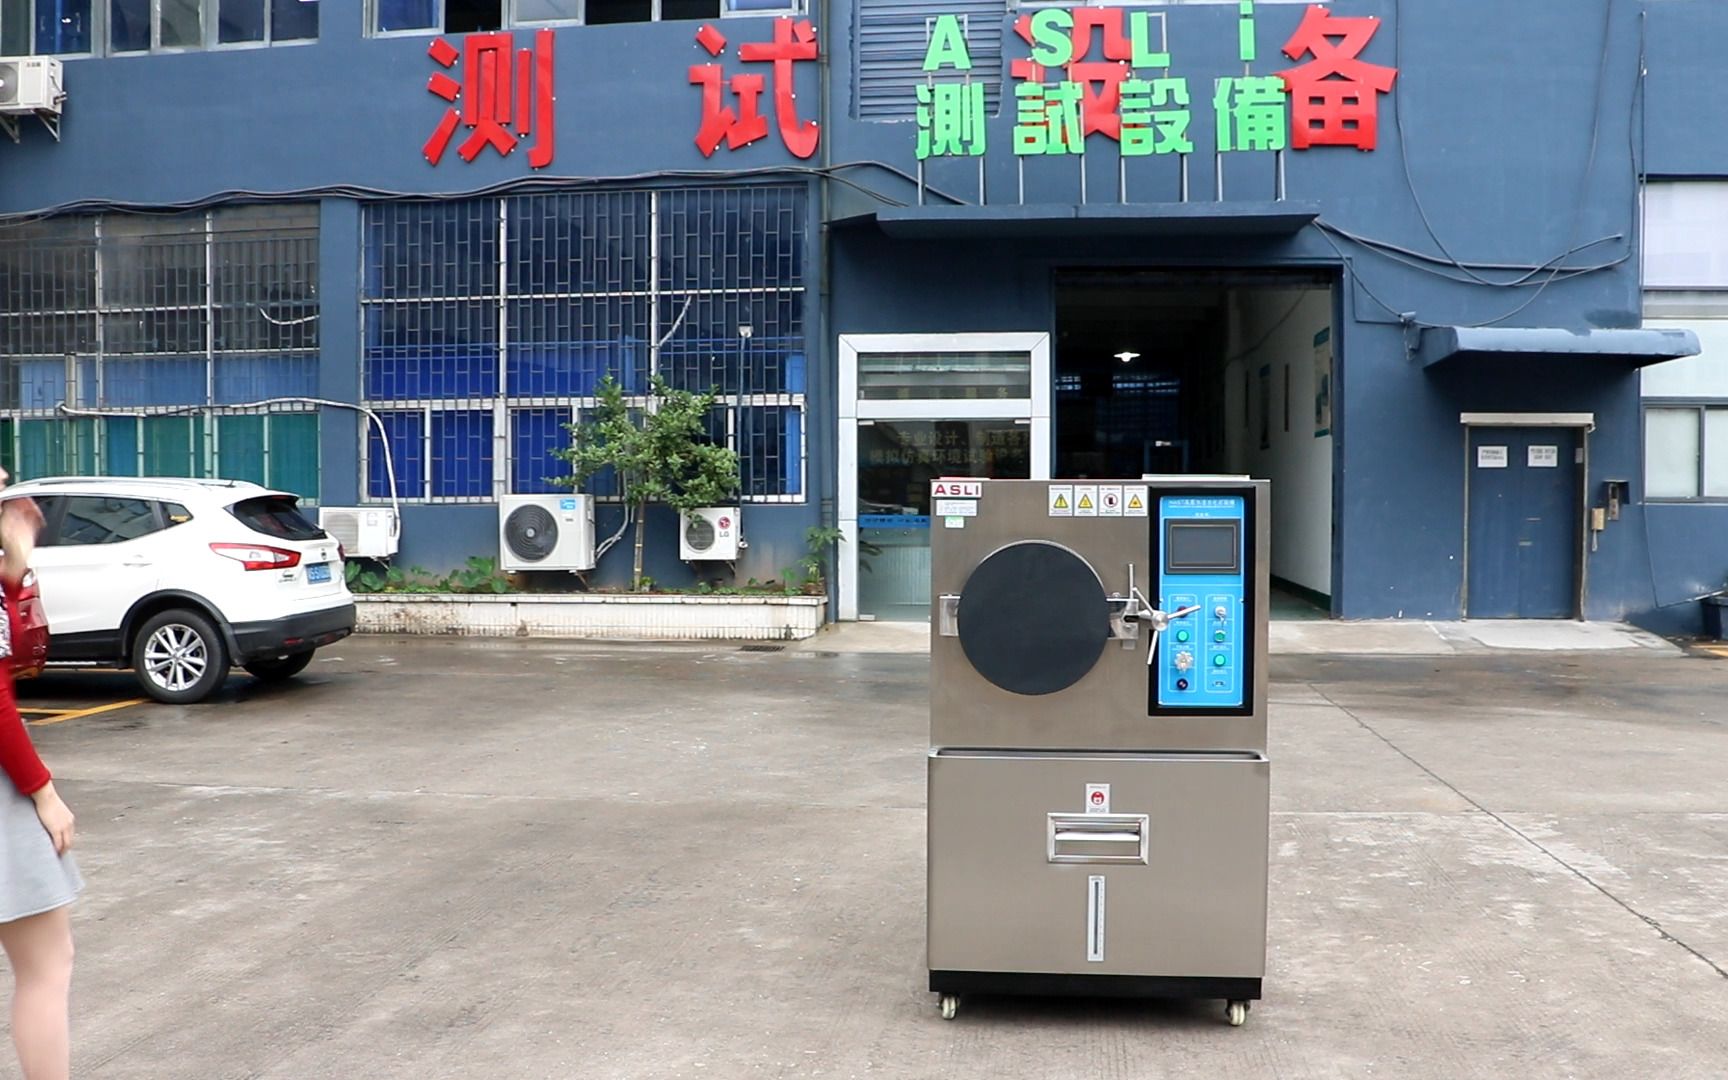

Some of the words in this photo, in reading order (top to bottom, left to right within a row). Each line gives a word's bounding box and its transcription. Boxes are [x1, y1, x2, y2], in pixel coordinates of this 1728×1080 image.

[915, 75, 1287, 160] 測試設備
[934, 484, 979, 496] ASLI
